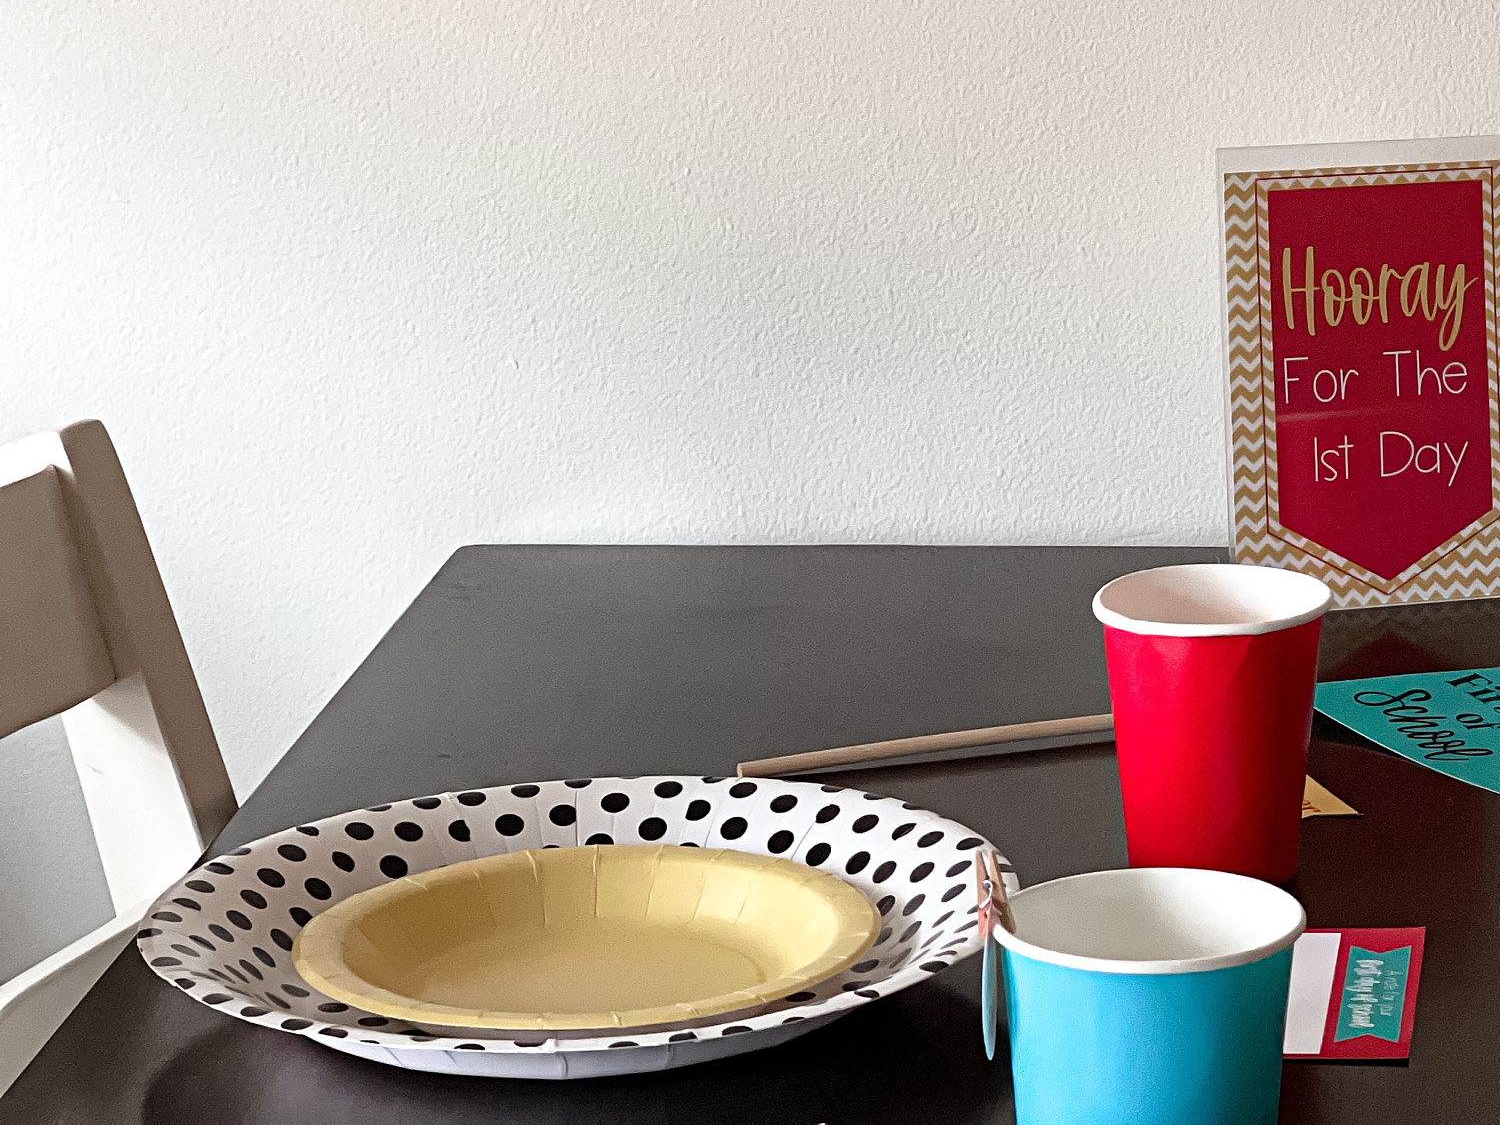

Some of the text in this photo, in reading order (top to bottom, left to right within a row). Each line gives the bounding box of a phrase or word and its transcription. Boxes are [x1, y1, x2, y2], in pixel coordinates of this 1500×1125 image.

[1282, 246, 1478, 352] Hooray
[1283, 349, 1468, 405] For The
[1379, 431, 1469, 488] Day
[1353, 688, 1493, 761] School
